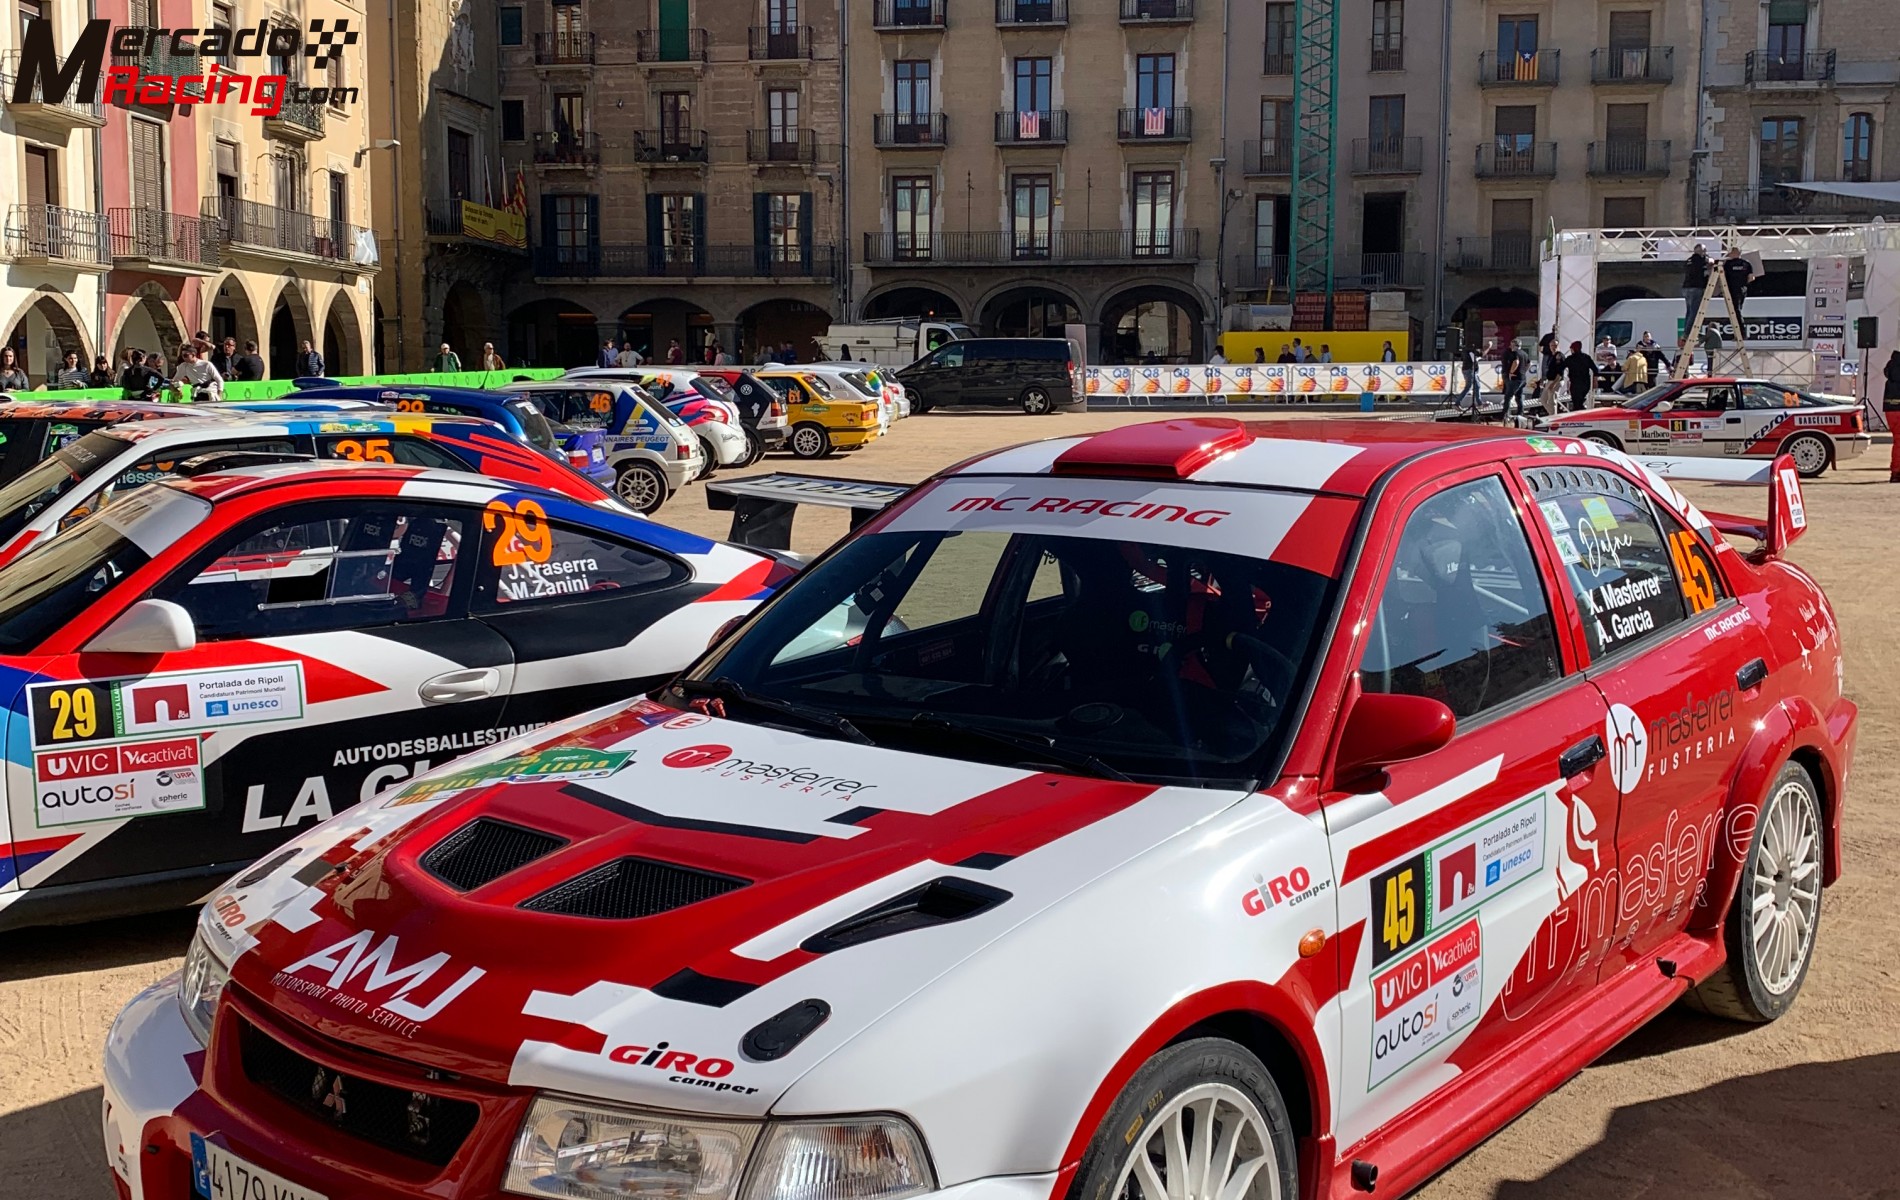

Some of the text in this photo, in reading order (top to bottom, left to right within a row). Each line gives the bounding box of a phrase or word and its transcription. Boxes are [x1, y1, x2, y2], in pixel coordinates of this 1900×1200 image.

[1113, 367, 1130, 378] Q8
[1143, 367, 1160, 378] Q8
[1173, 367, 1190, 378] Q8
[1204, 367, 1221, 378] Q8
[1235, 367, 1252, 377] Q8
[1266, 367, 1284, 377] Q8
[1298, 367, 1315, 377] Q8
[1330, 366, 1348, 376] Q8
[1363, 366, 1380, 376] Q8
[1395, 365, 1413, 376] Q8
[1428, 365, 1446, 375] Q8
[589, 392, 612, 414] 46
[1641, 430, 1670, 438] Marlboro
[1674, 420, 1683, 431] 81
[946, 497, 1232, 527] MC RACING
[483, 498, 553, 567] 29
[1669, 530, 1718, 615] 45
[1600, 575, 1661, 612] Masferrer
[1611, 605, 1655, 640] Garcia
[1704, 607, 1751, 640] MC RACING
[199, 674, 285, 690] Portalada de Ripoll
[199, 685, 286, 700] Candidatura Patrimoni Mundial
[50, 687, 97, 740] 29
[232, 698, 279, 712] unesco
[1650, 685, 1735, 755] masferrer
[333, 721, 552, 767] AUTODESBALLESTAM
[1648, 727, 1735, 783] FUSTERIA
[47, 752, 109, 777] UVIC
[714, 757, 878, 794] masferrer
[42, 770, 196, 810] autosí URPI
[701, 767, 853, 802] FUSTERIA
[158, 792, 188, 803] spheric
[241, 775, 334, 834] LA
[1483, 812, 1537, 848] Portalada de Ripoll
[1482, 845, 1506, 862] Candidatura
[1502, 848, 1532, 873] unesco
[1581, 803, 1761, 949] masferre
[1289, 879, 1331, 907] camper
[1427, 886, 1432, 897] LA
[1382, 868, 1416, 951] 45
[1566, 869, 1741, 986] FUSTERI
[1381, 962, 1423, 1009] UVIC
[1463, 968, 1478, 982] URPI
[272, 972, 423, 1040] MOTORSPORT PHOTO SERVICE
[1451, 1001, 1472, 1022] spheric
[1375, 992, 1439, 1060] autosí
[668, 1075, 760, 1096] camper
